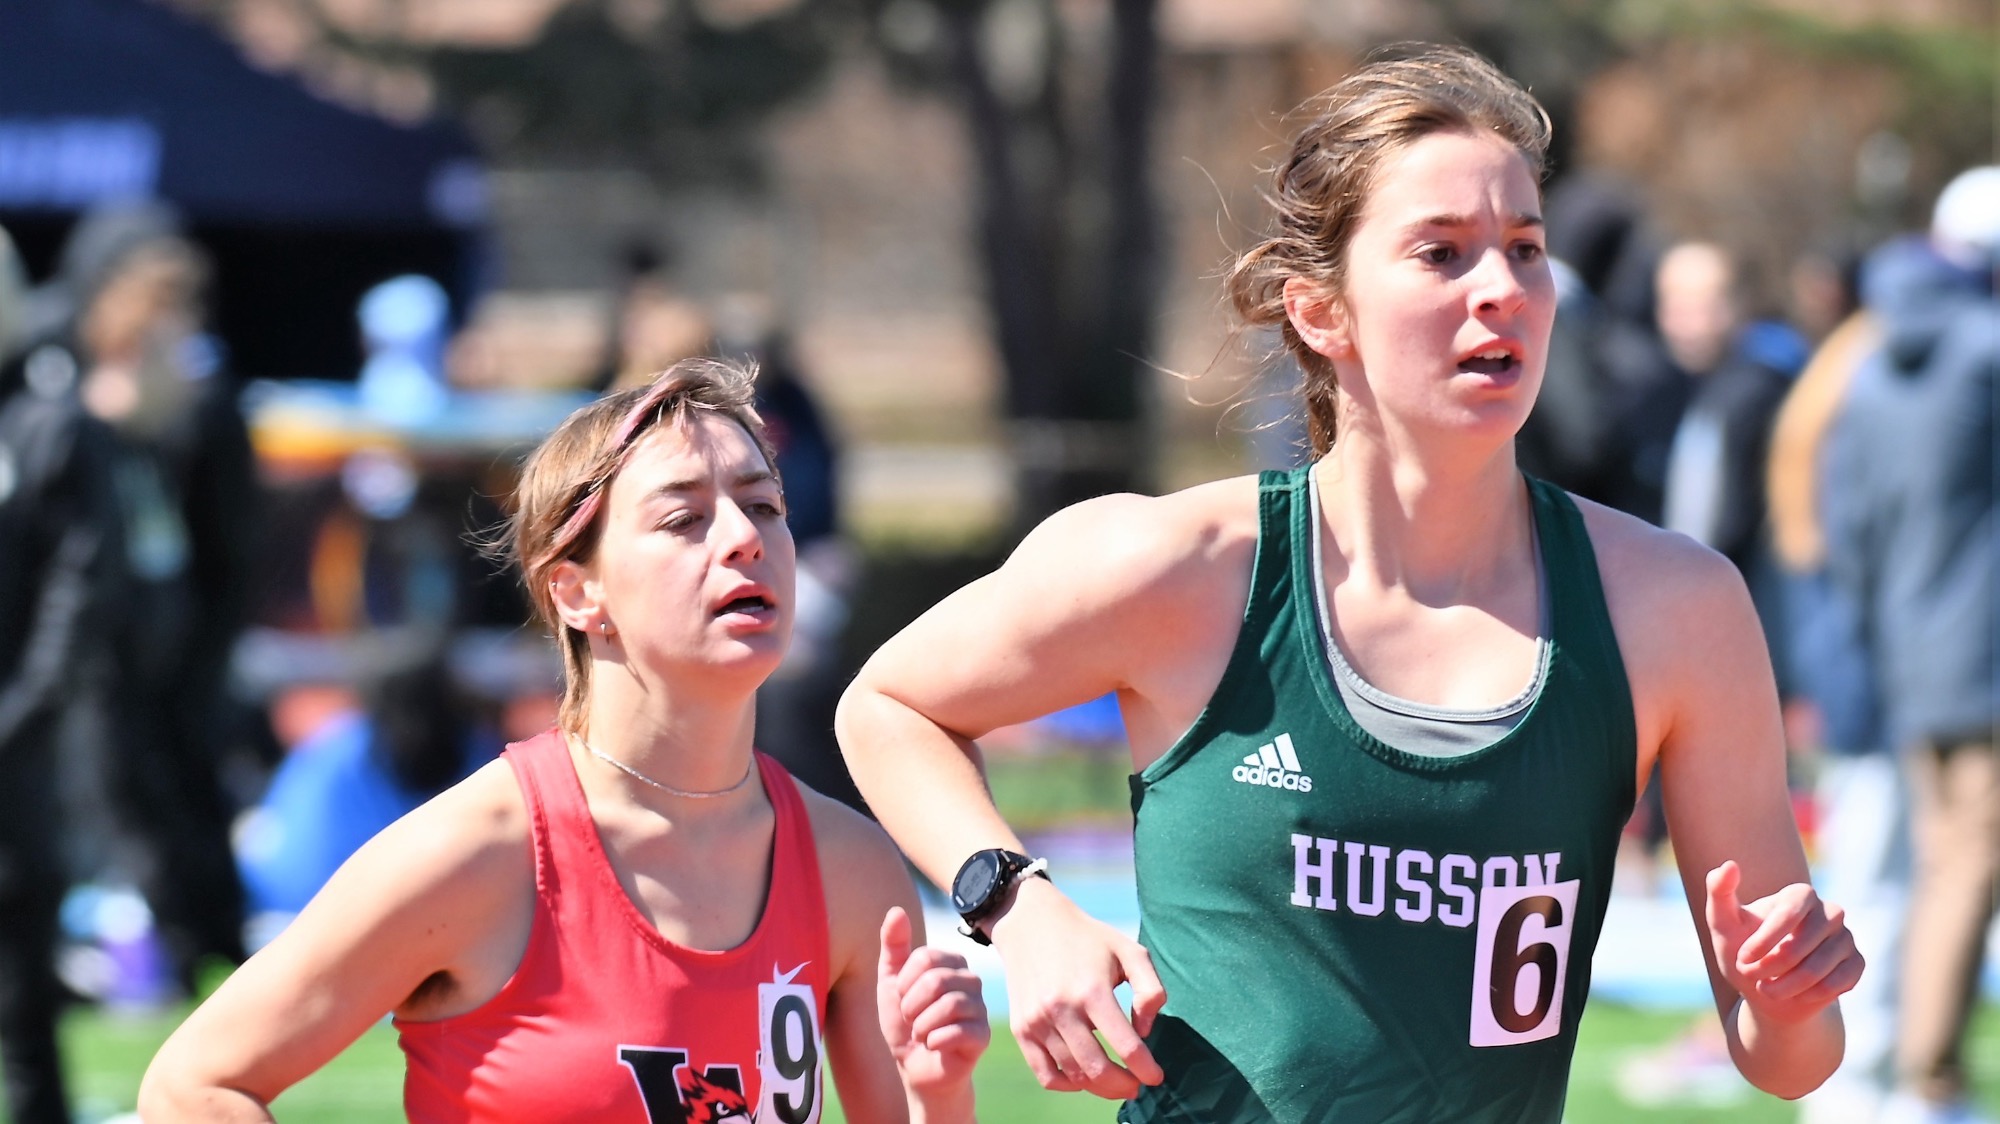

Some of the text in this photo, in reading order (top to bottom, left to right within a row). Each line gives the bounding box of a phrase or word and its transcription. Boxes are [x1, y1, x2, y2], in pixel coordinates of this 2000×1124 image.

[1232, 765, 1312, 792] adidas
[1489, 896, 1562, 1033] 6
[771, 995, 818, 1124] 9
